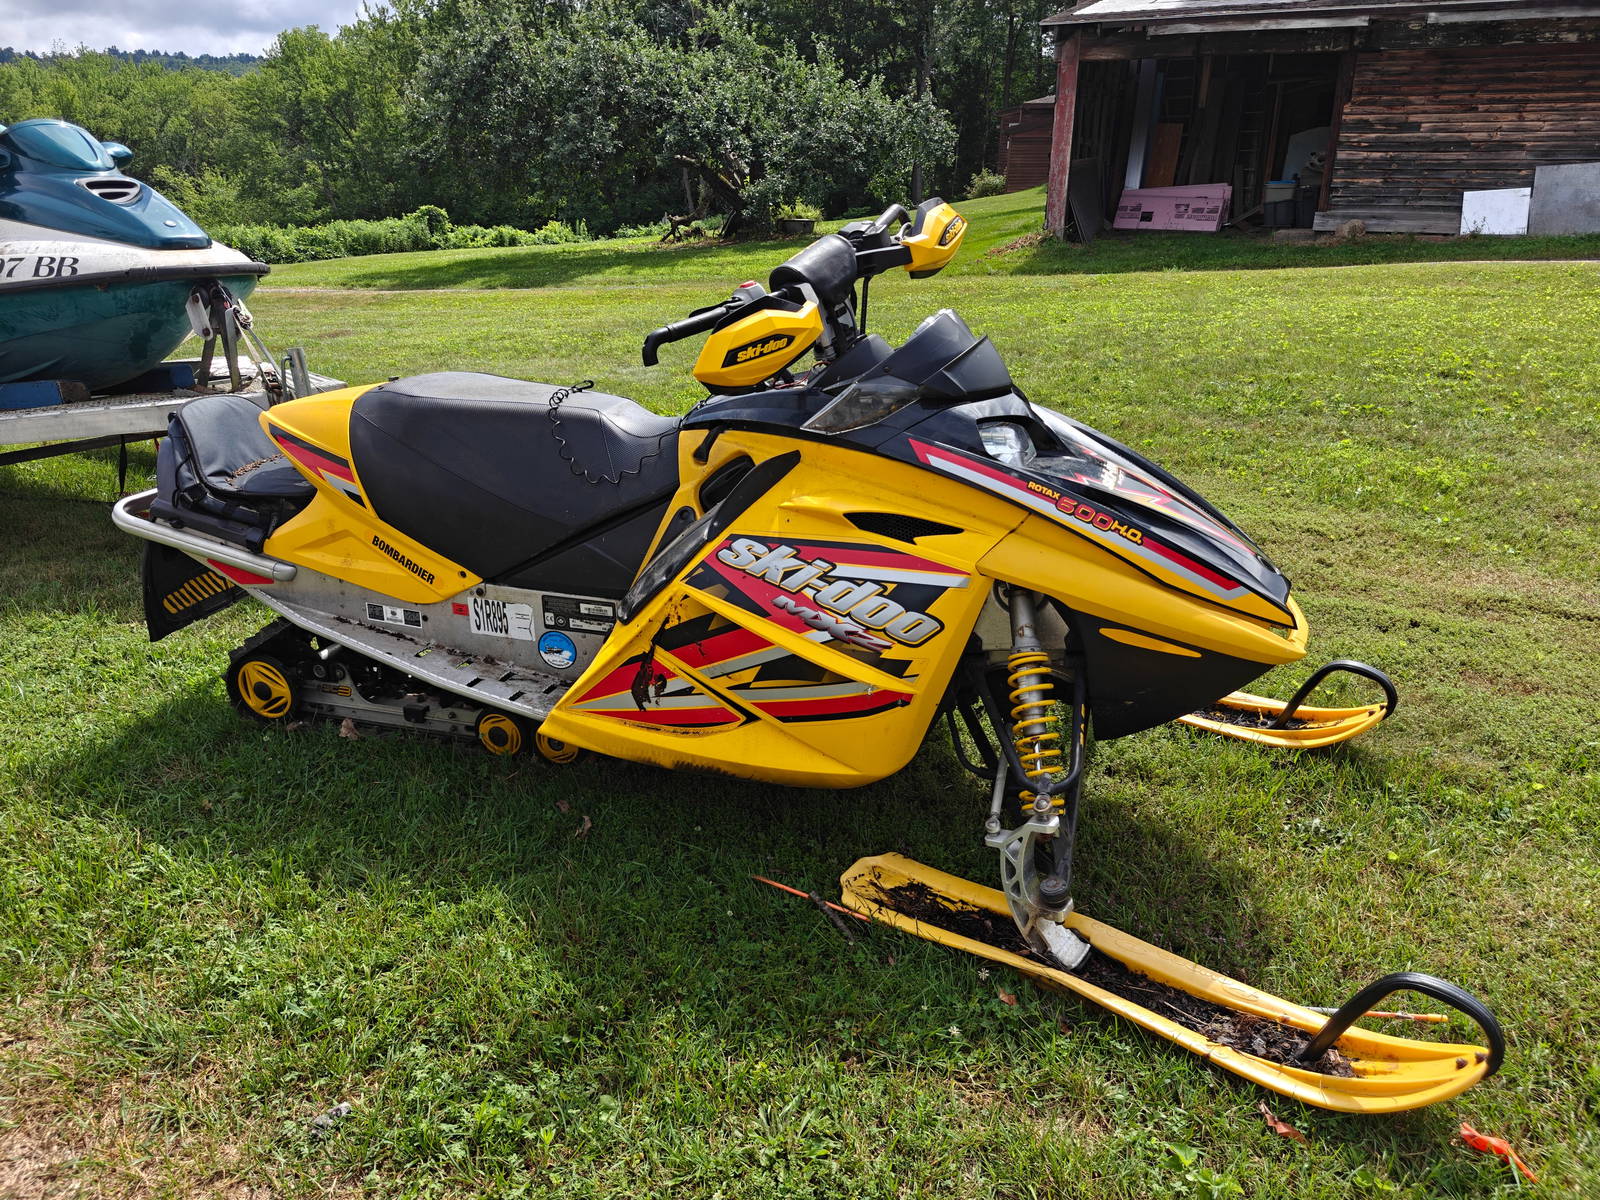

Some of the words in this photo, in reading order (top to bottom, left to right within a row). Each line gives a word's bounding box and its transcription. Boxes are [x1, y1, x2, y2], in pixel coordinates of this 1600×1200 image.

[32, 256, 79, 278] BB
[737, 337, 788, 362] ski-doo
[1027, 480, 1061, 500] ROTAX
[1055, 496, 1114, 531] 600
[371, 534, 435, 585] BOMBARDIER
